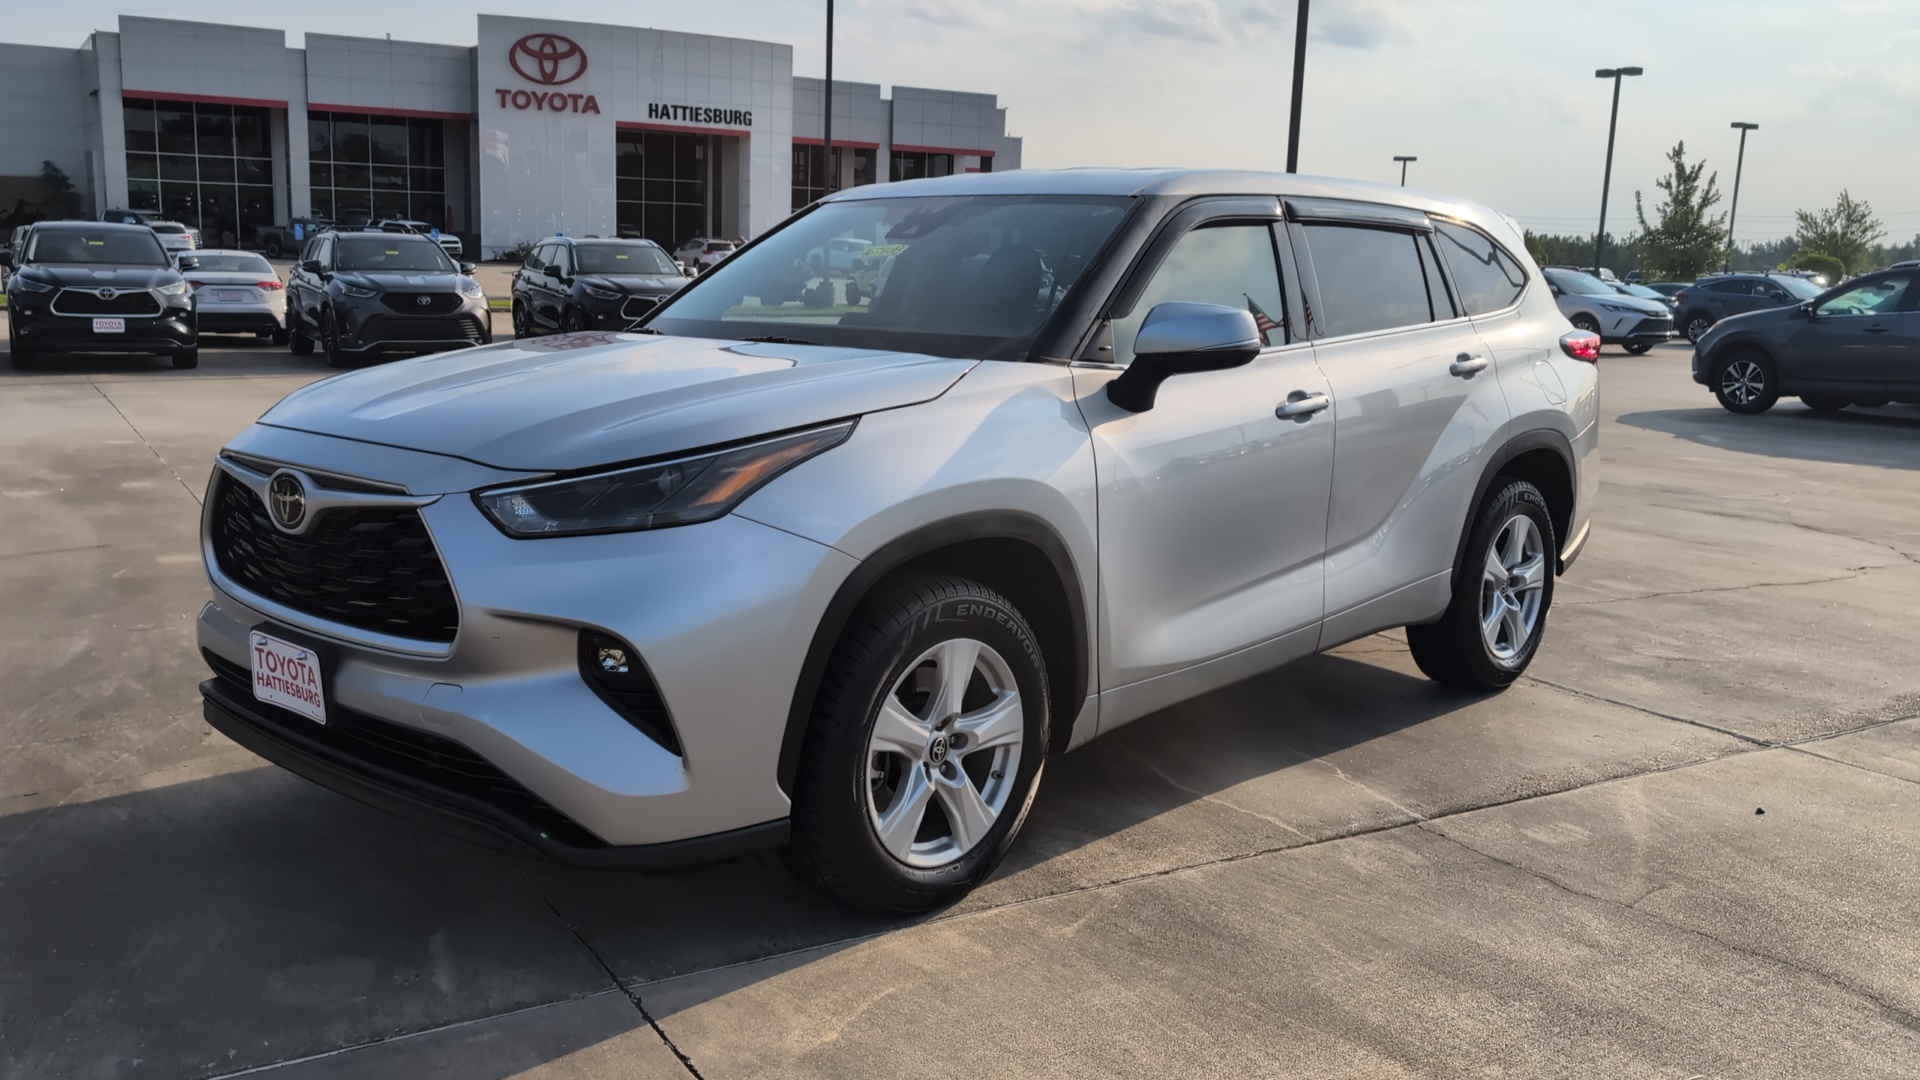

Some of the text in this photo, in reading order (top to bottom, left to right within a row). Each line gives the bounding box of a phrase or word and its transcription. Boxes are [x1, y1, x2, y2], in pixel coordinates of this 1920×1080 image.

[495, 89, 600, 114] TOYOTA
[648, 103, 752, 126] HATTIESBURG
[956, 603, 1040, 668] ENDEAVOR
[255, 646, 318, 690] TOYOTA
[256, 671, 321, 708] HATTIESBURG
